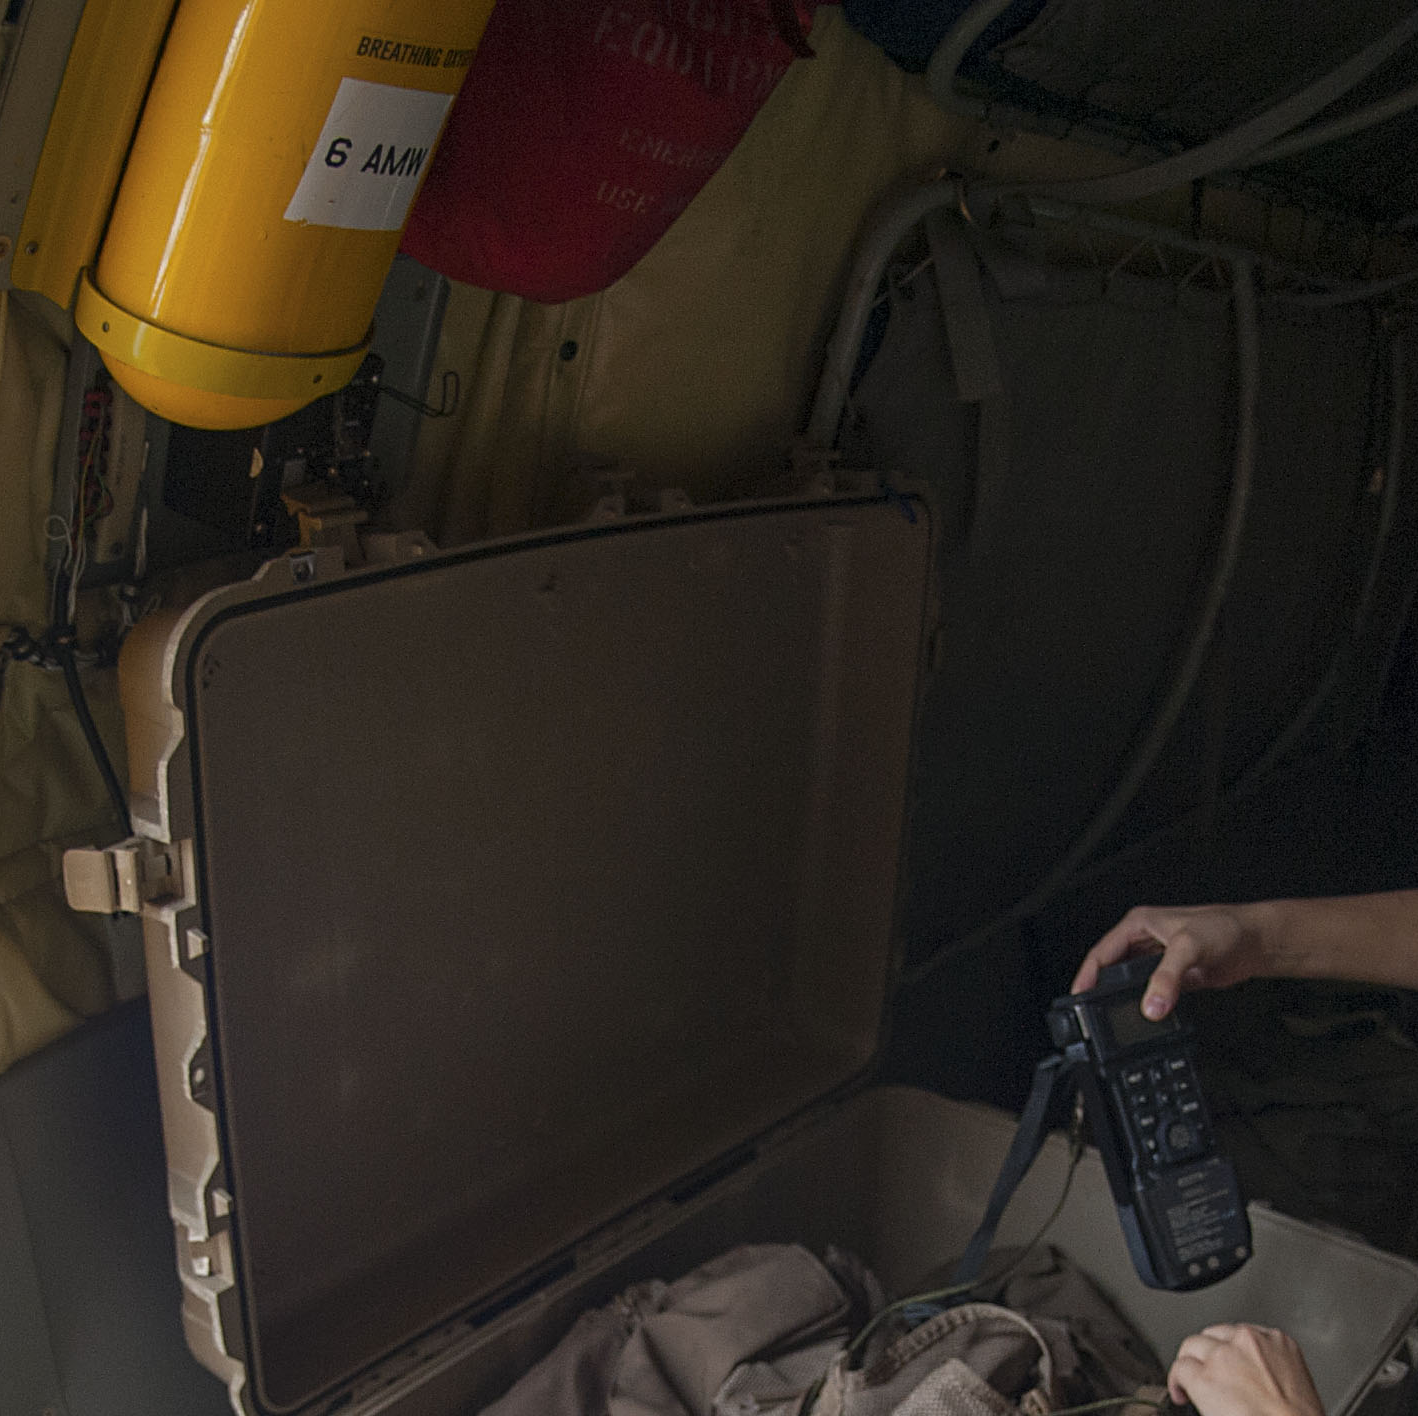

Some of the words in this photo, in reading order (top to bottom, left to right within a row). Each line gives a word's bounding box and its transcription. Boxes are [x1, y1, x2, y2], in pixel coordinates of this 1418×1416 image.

[356, 36, 443, 67] BREATHING
[324, 137, 353, 168] 6
[360, 143, 430, 177] AMW
